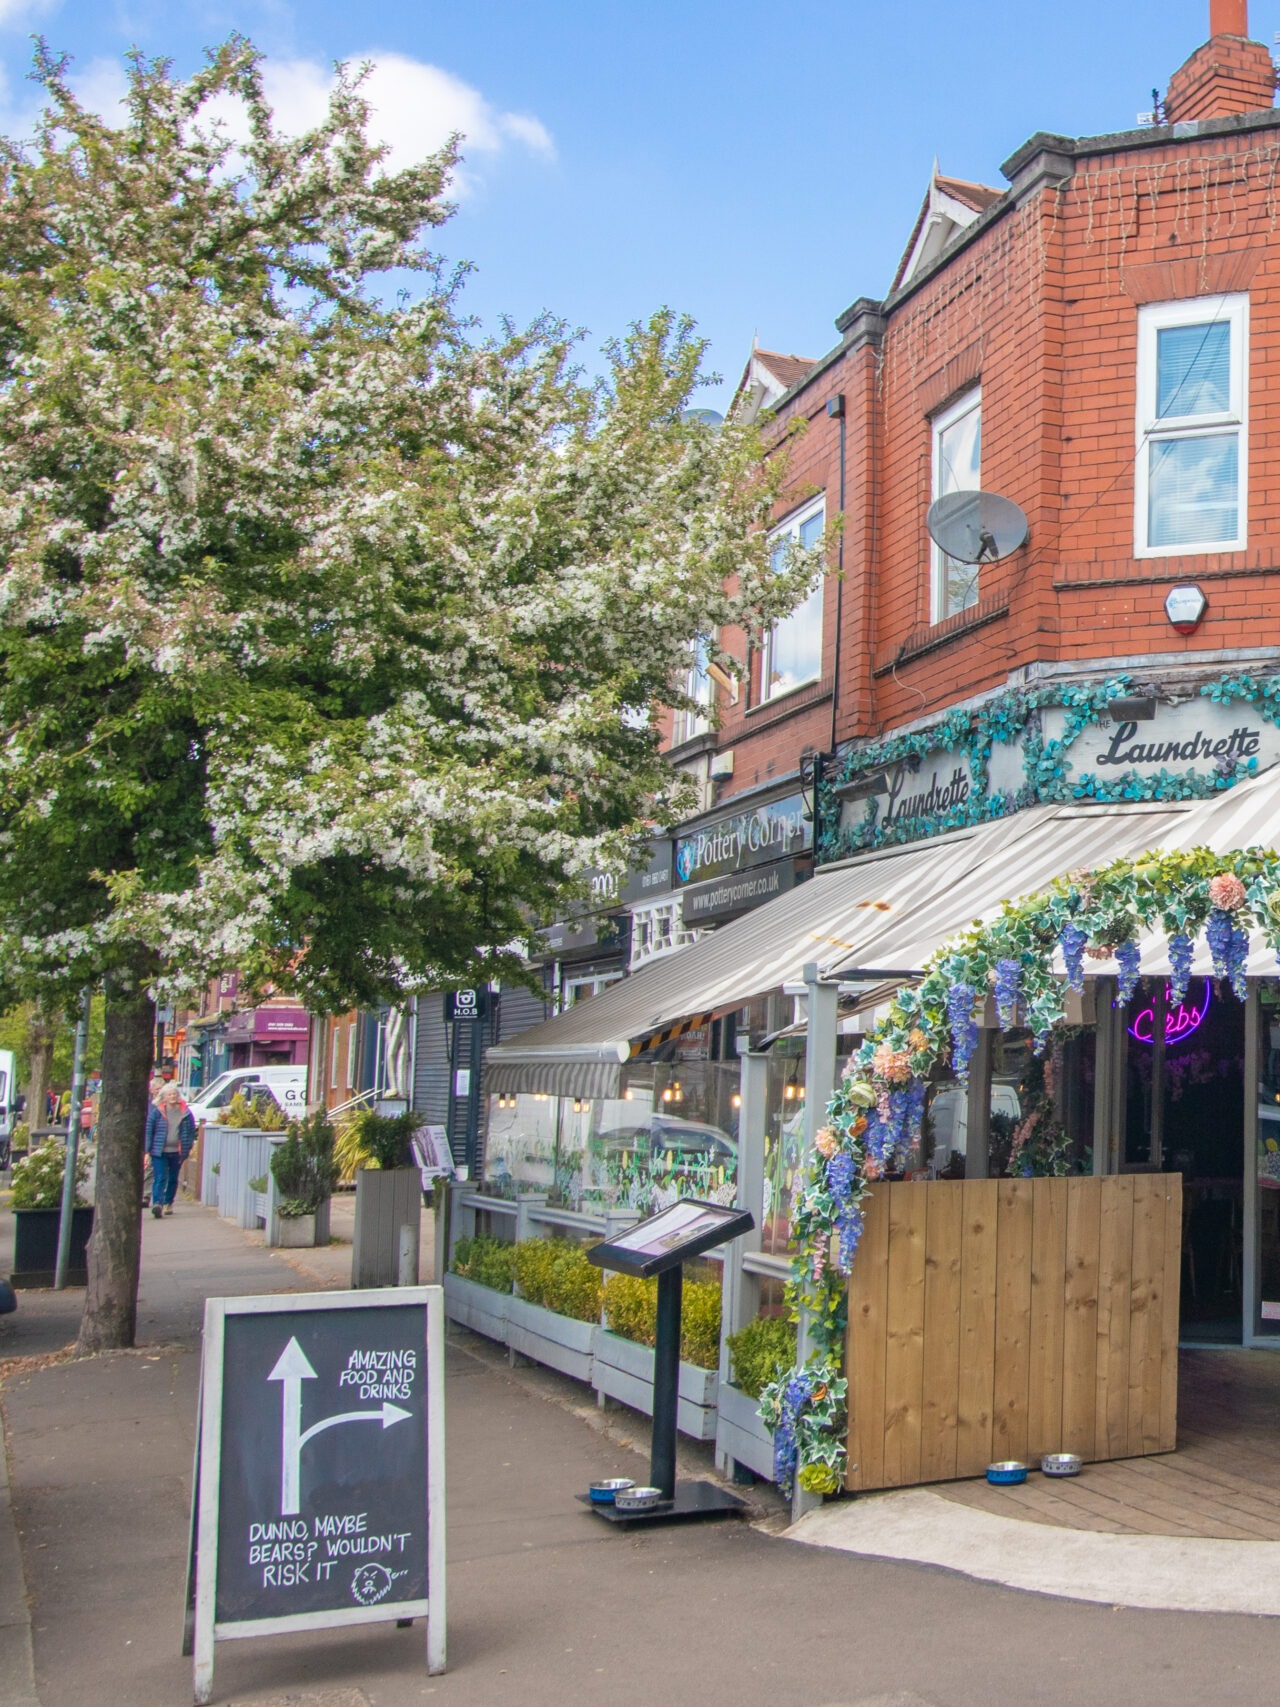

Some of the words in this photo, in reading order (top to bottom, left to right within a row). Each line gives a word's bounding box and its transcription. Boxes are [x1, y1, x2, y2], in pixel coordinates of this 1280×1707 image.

[1096, 721, 1260, 765] Laundrette
[882, 765, 969, 830] Laundrette
[695, 832, 743, 869] Pottery
[748, 809, 802, 852] Corner
[693, 871, 779, 911] www.potterycorner.co.uk
[1134, 1004, 1201, 1040] Crbs
[348, 1350, 417, 1369] AMAZING
[339, 1370, 377, 1387] FOOD
[382, 1368, 415, 1384] AND
[360, 1383, 411, 1400] DRINKS
[249, 1520, 309, 1543] DUNNO,
[315, 1513, 368, 1538] MAYBE
[249, 1541, 318, 1565] BEARS?
[326, 1532, 412, 1557] WOULDN'T
[263, 1562, 310, 1588] RISK
[316, 1560, 338, 1582] IT
